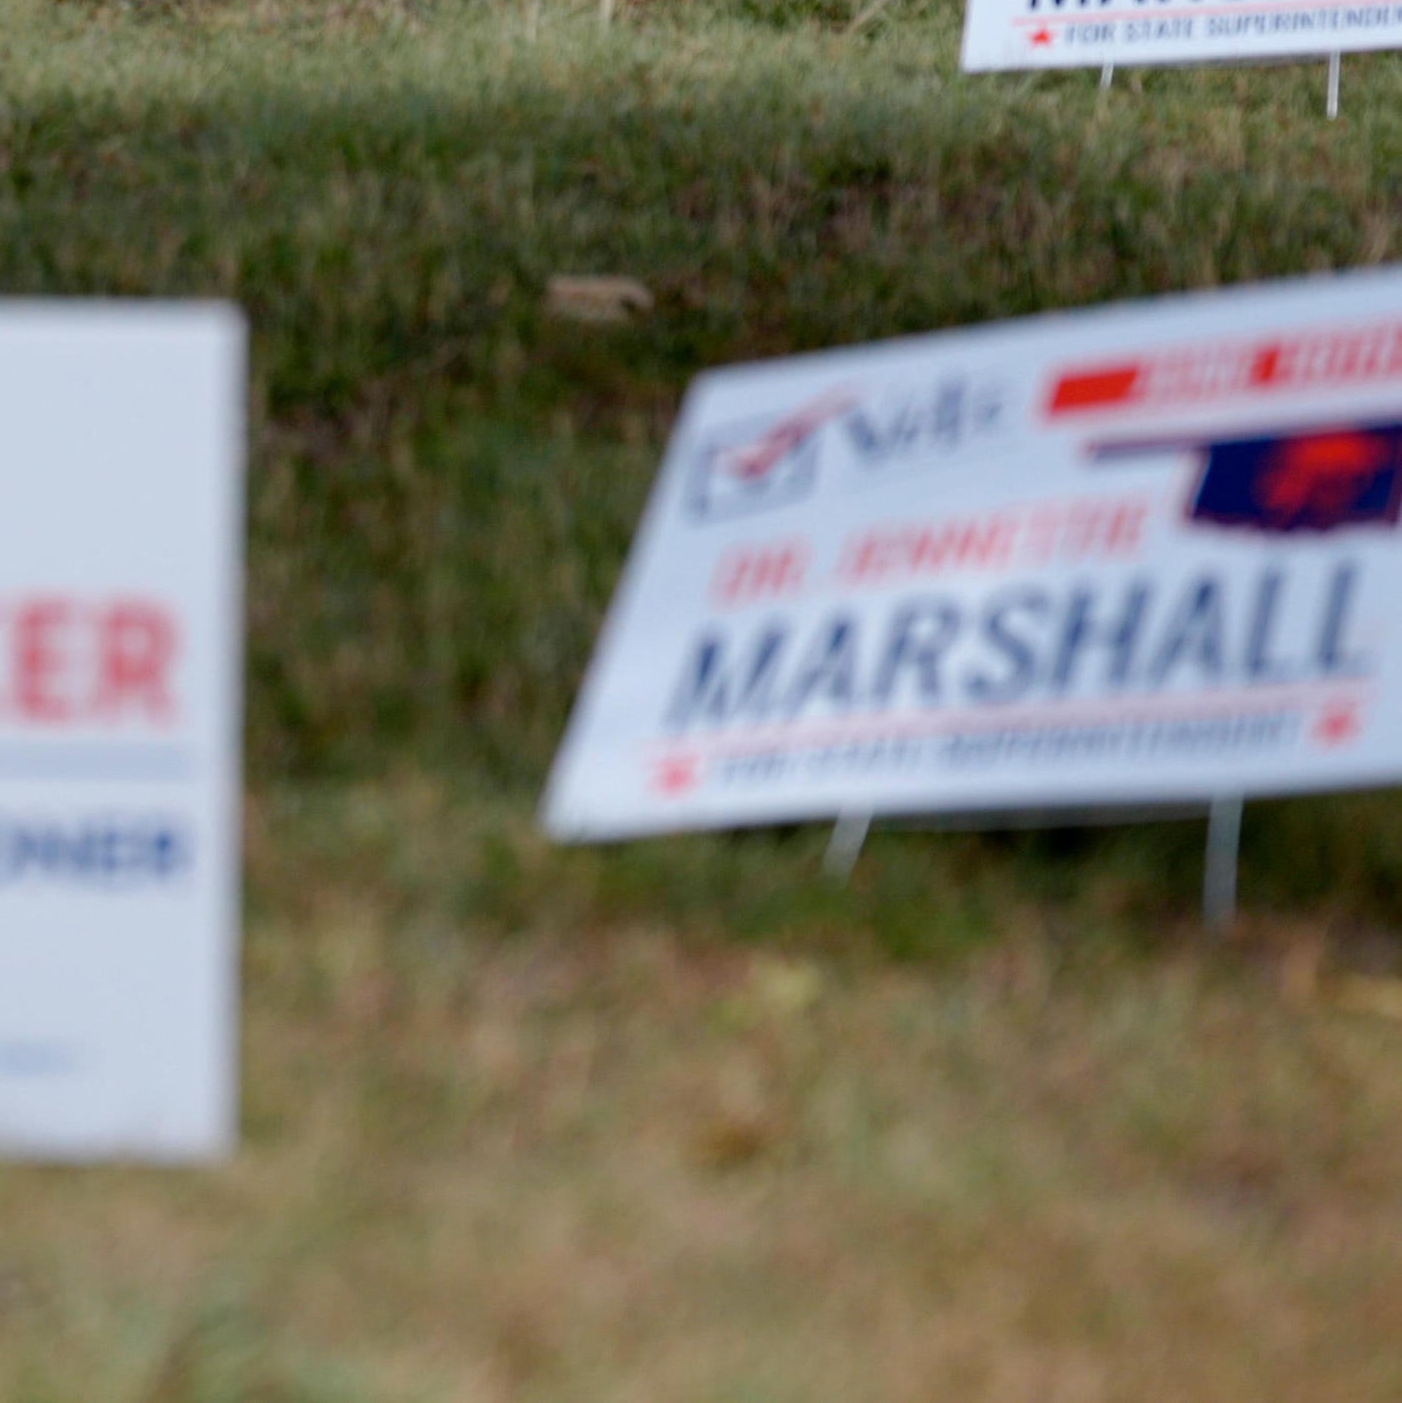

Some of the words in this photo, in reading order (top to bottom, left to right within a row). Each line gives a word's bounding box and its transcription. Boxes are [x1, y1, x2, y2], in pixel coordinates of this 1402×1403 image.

[1064, 20, 1116, 46] FOR
[1125, 18, 1193, 43] STATE
[662, 555, 1375, 734] MARSHALL
